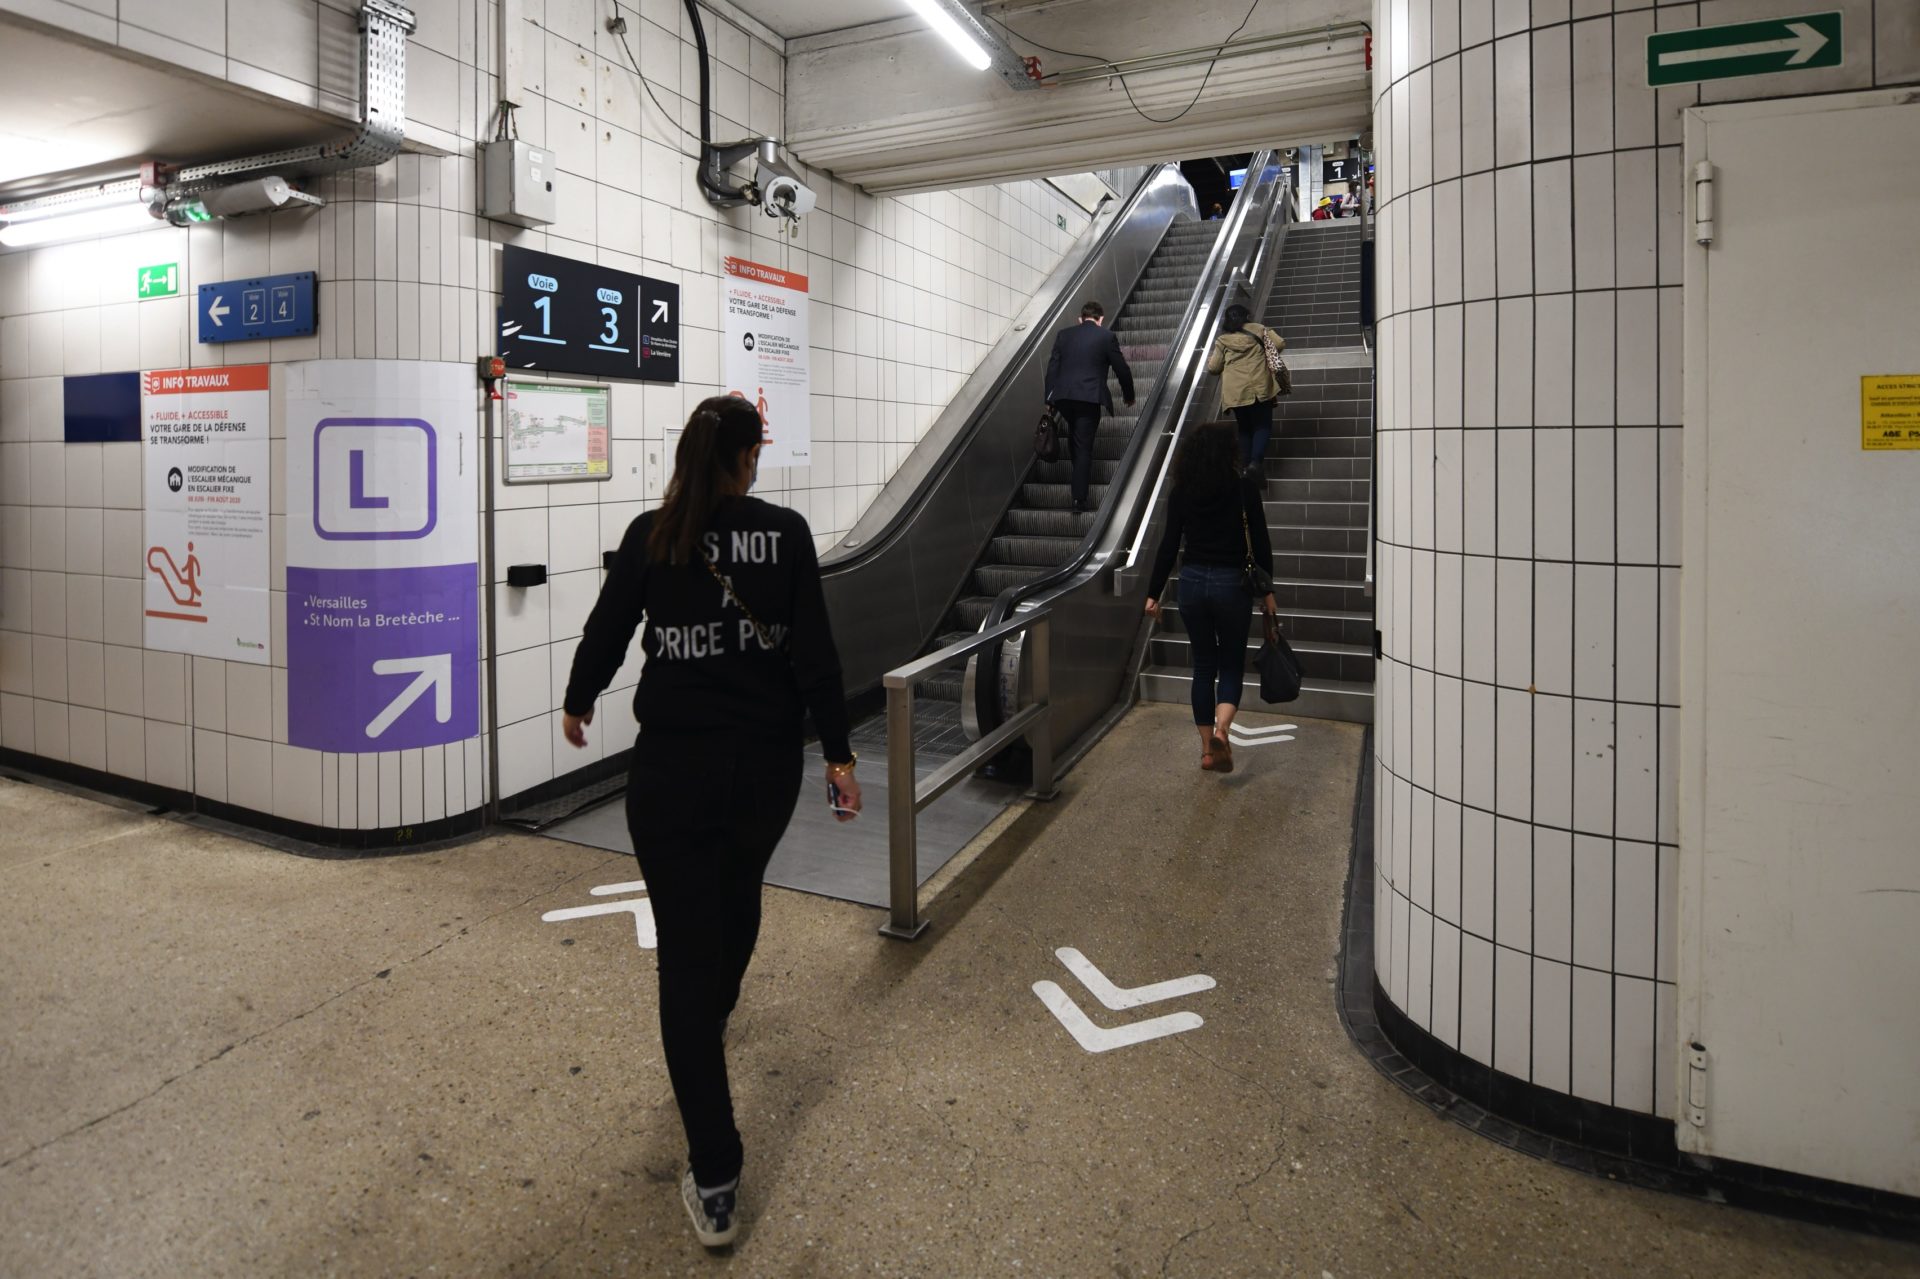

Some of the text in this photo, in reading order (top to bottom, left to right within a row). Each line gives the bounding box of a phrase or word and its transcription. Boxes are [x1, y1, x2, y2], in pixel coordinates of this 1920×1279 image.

[1334, 167, 1342, 178] 1
[739, 264, 786, 284] INFO TRAVAUX
[532, 276, 618, 302] Voie Voie
[729, 298, 745, 306] VOTRE
[747, 301, 760, 309] GARE
[758, 294, 785, 305] ACCESSIBLE
[250, 300, 287, 320] 2 4
[737, 308, 770, 320] TRANSFORME
[534, 296, 618, 344] 1 3
[163, 374, 229, 389] INFO TRAVAUX
[188, 410, 228, 420] ACCESSIBLE
[150, 422, 246, 433] VOTRE GARE DE LA DÉFENSE
[150, 436, 158, 444] SE
[160, 436, 204, 444] TRANSFORME
[218, 474, 251, 483] MÉCANIQUE
[350, 450, 388, 508] L
[731, 531, 781, 564] NOT
[722, 576, 738, 608] A
[310, 595, 367, 609] Versailles
[310, 613, 320, 626] St
[323, 615, 353, 627] Nom
[358, 615, 370, 627] la
[375, 611, 444, 626] Bretèche
